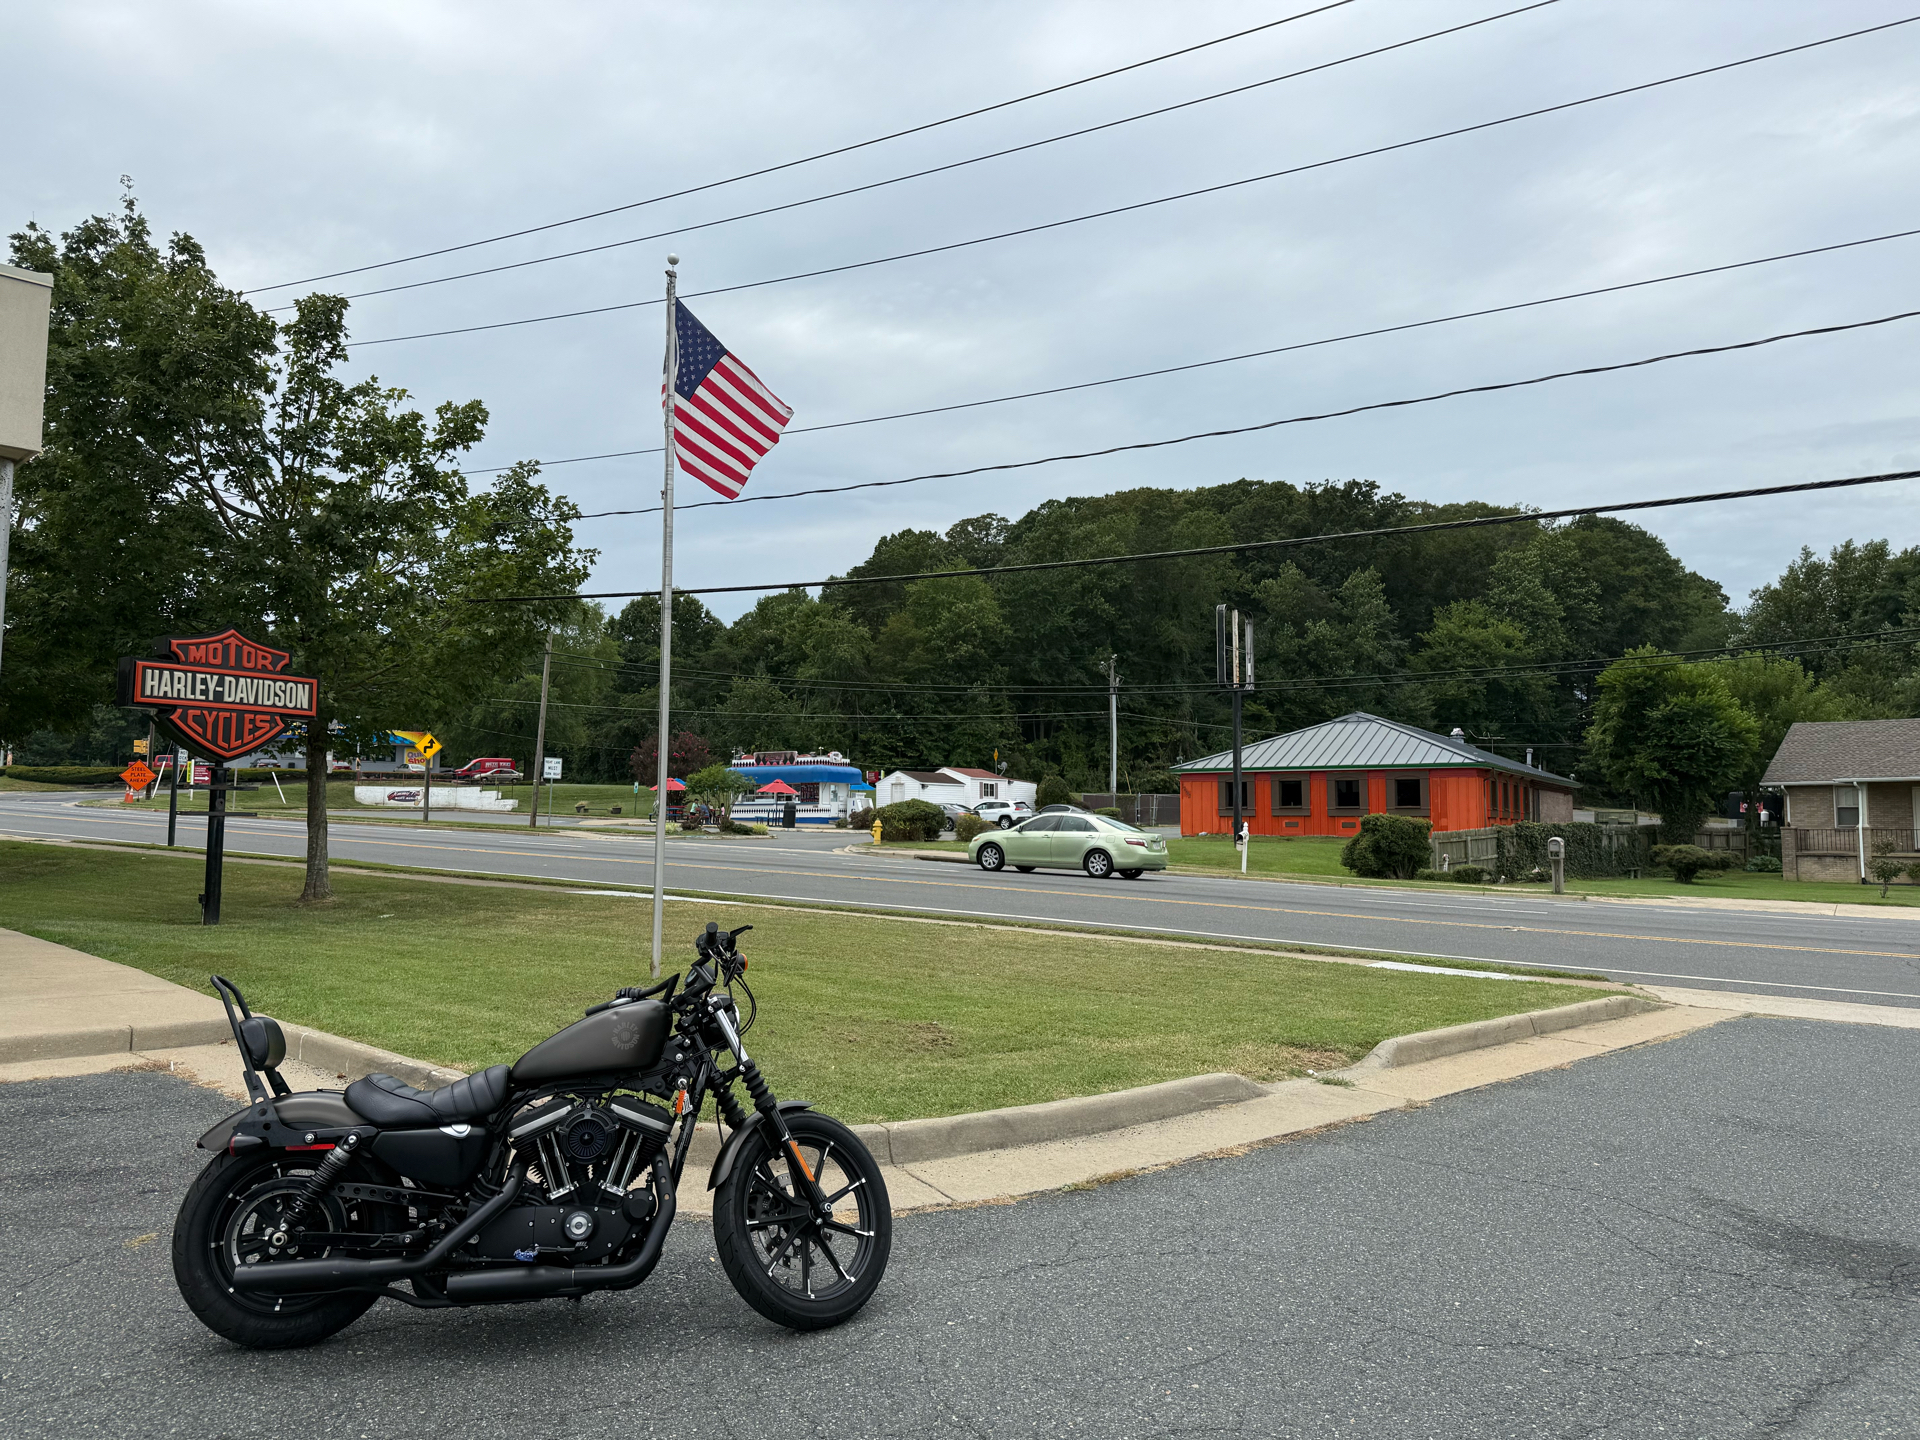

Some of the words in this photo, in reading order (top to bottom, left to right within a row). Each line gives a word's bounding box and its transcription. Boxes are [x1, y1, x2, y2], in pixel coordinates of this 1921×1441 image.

[187, 636, 274, 672] MOTOR
[144, 668, 310, 710] HARLEY-DAVIDSON
[186, 709, 271, 750] CYCLES
[611, 1034, 640, 1050] DAVIDSON
[612, 1021, 639, 1035] HARLEY
